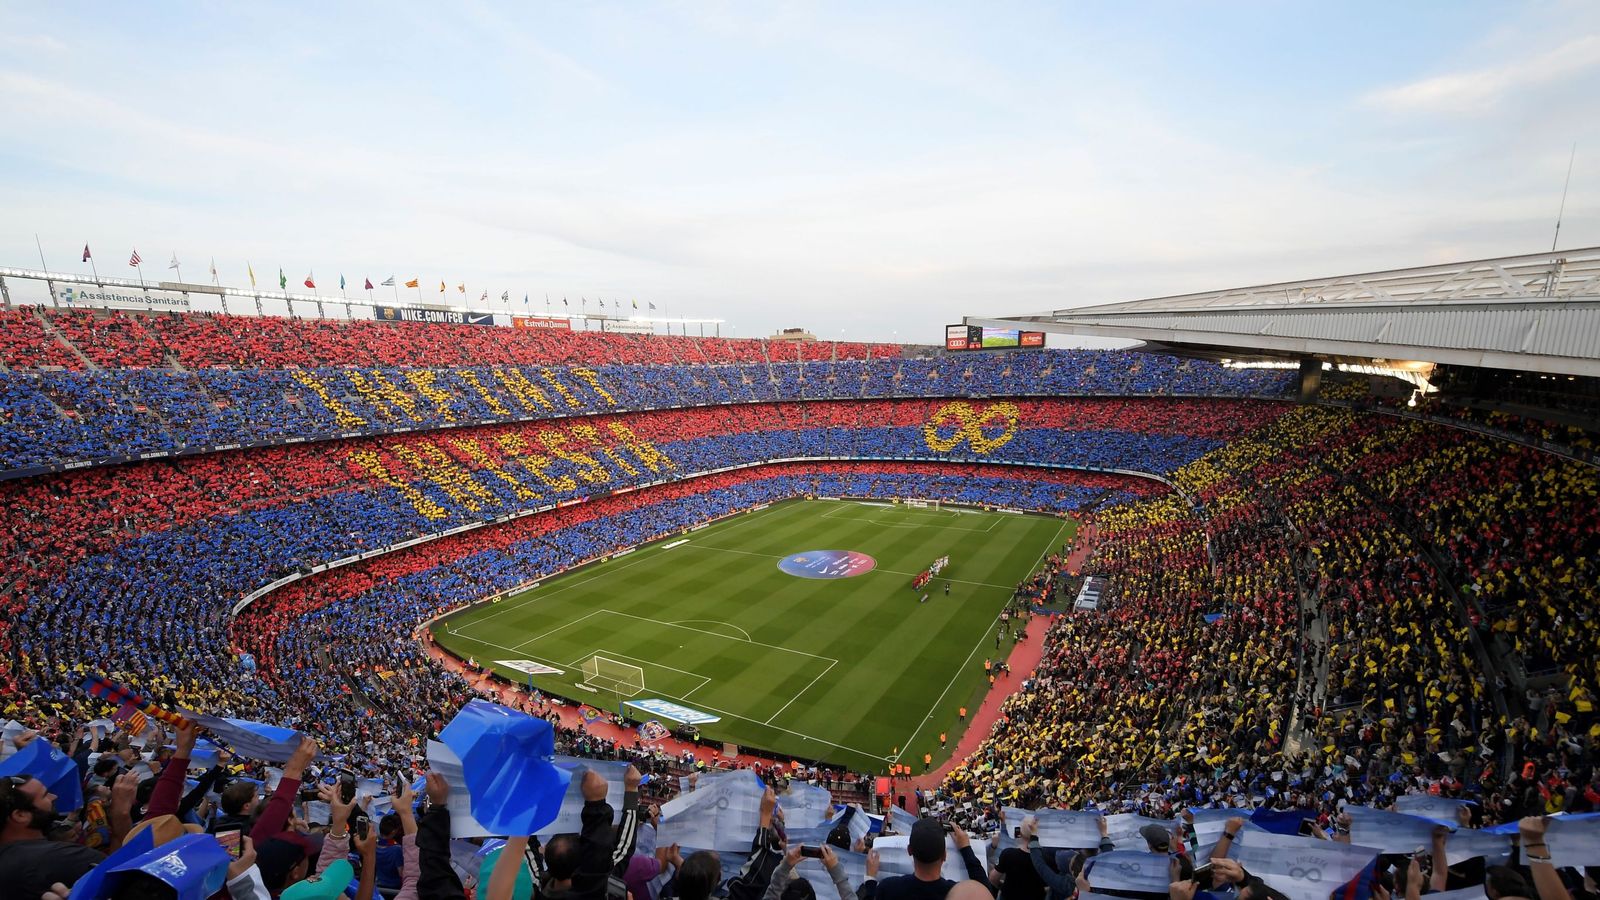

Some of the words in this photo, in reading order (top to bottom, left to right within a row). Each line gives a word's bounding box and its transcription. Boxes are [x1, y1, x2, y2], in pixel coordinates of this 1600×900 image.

[79, 290, 144, 303] Assistència
[144, 295, 190, 306] Sanitària
[400, 308, 464, 323] NIKE.COM/FCB
[524, 319, 549, 329] Estrella
[549, 320, 569, 329] Damm
